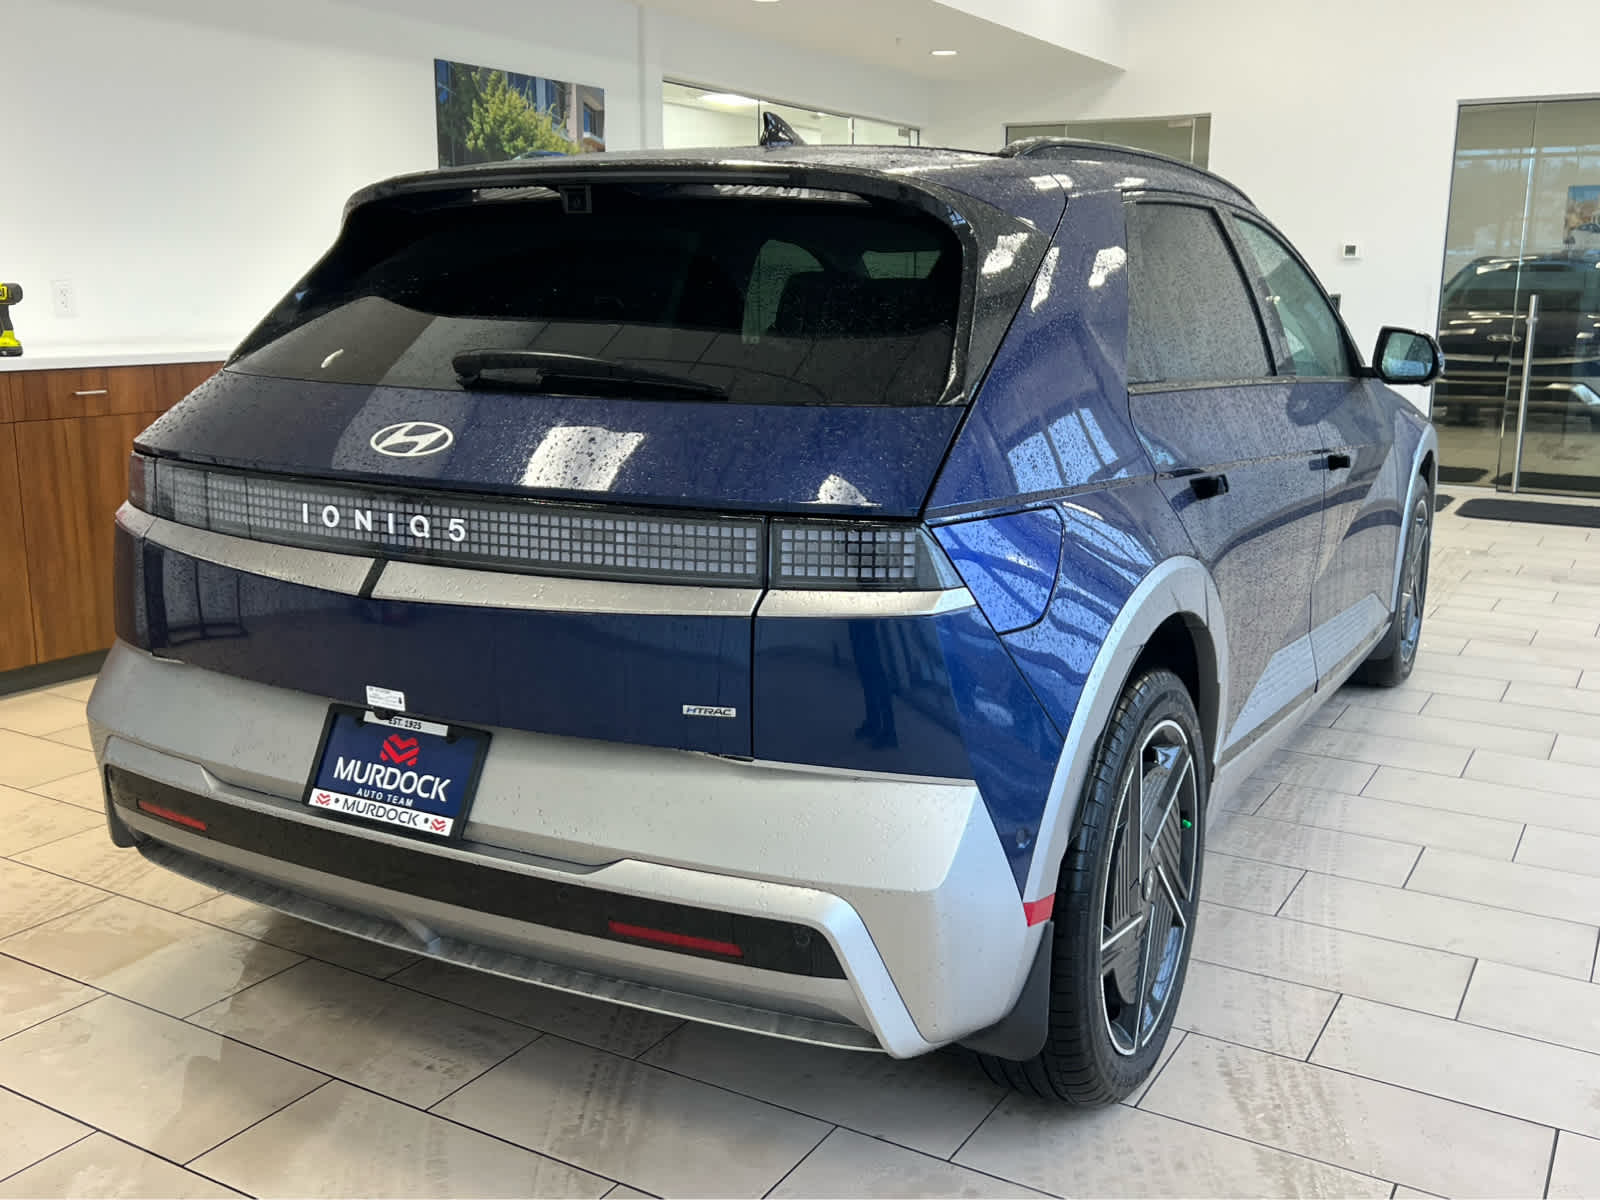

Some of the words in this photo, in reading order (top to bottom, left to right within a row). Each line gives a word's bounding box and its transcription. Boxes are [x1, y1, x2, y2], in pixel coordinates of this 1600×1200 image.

[301, 503, 430, 539] IONIQ
[448, 518, 467, 543] 5
[686, 706, 732, 716] HTRAC
[404, 718, 422, 730] 1925
[333, 756, 452, 802] MURDOCK
[356, 788, 384, 801] AUTO
[387, 794, 414, 807] TEAM
[341, 798, 421, 826] MURDOCK
